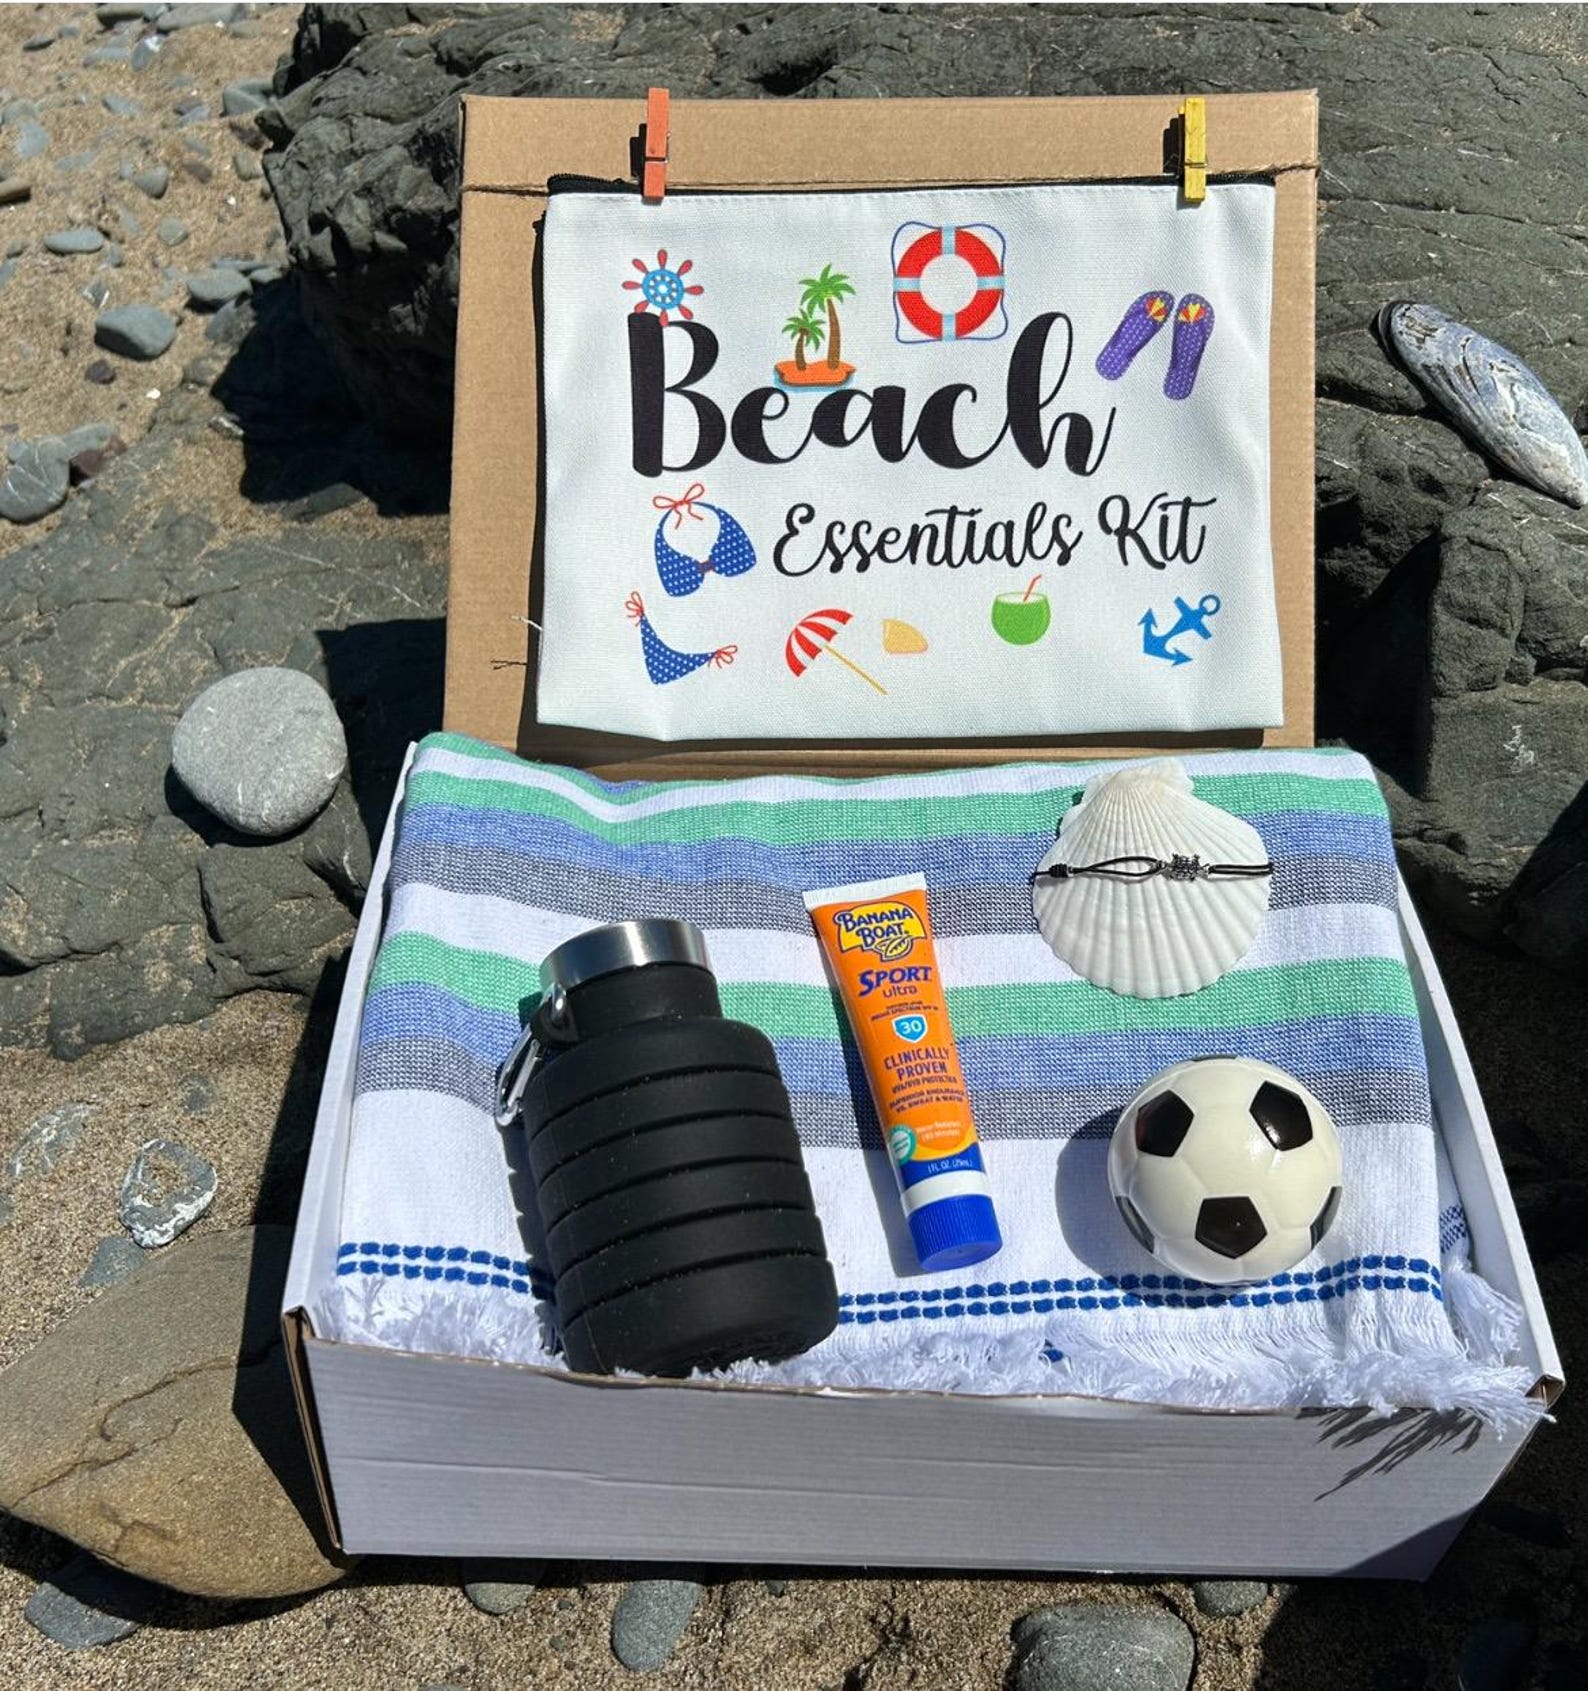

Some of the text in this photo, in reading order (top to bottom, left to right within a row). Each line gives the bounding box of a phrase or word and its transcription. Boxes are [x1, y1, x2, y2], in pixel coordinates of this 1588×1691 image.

[628, 311, 1116, 477] Beach
[773, 492, 1217, 577] Essentials Kit
[837, 908, 914, 933] BANANA
[856, 922, 904, 948] BOAT
[859, 966, 932, 997] SPORT
[883, 985, 917, 998] ultra
[900, 1020, 922, 1034] 30
[884, 1047, 950, 1070] CLINICALLY
[897, 1061, 948, 1081] PROVEN
